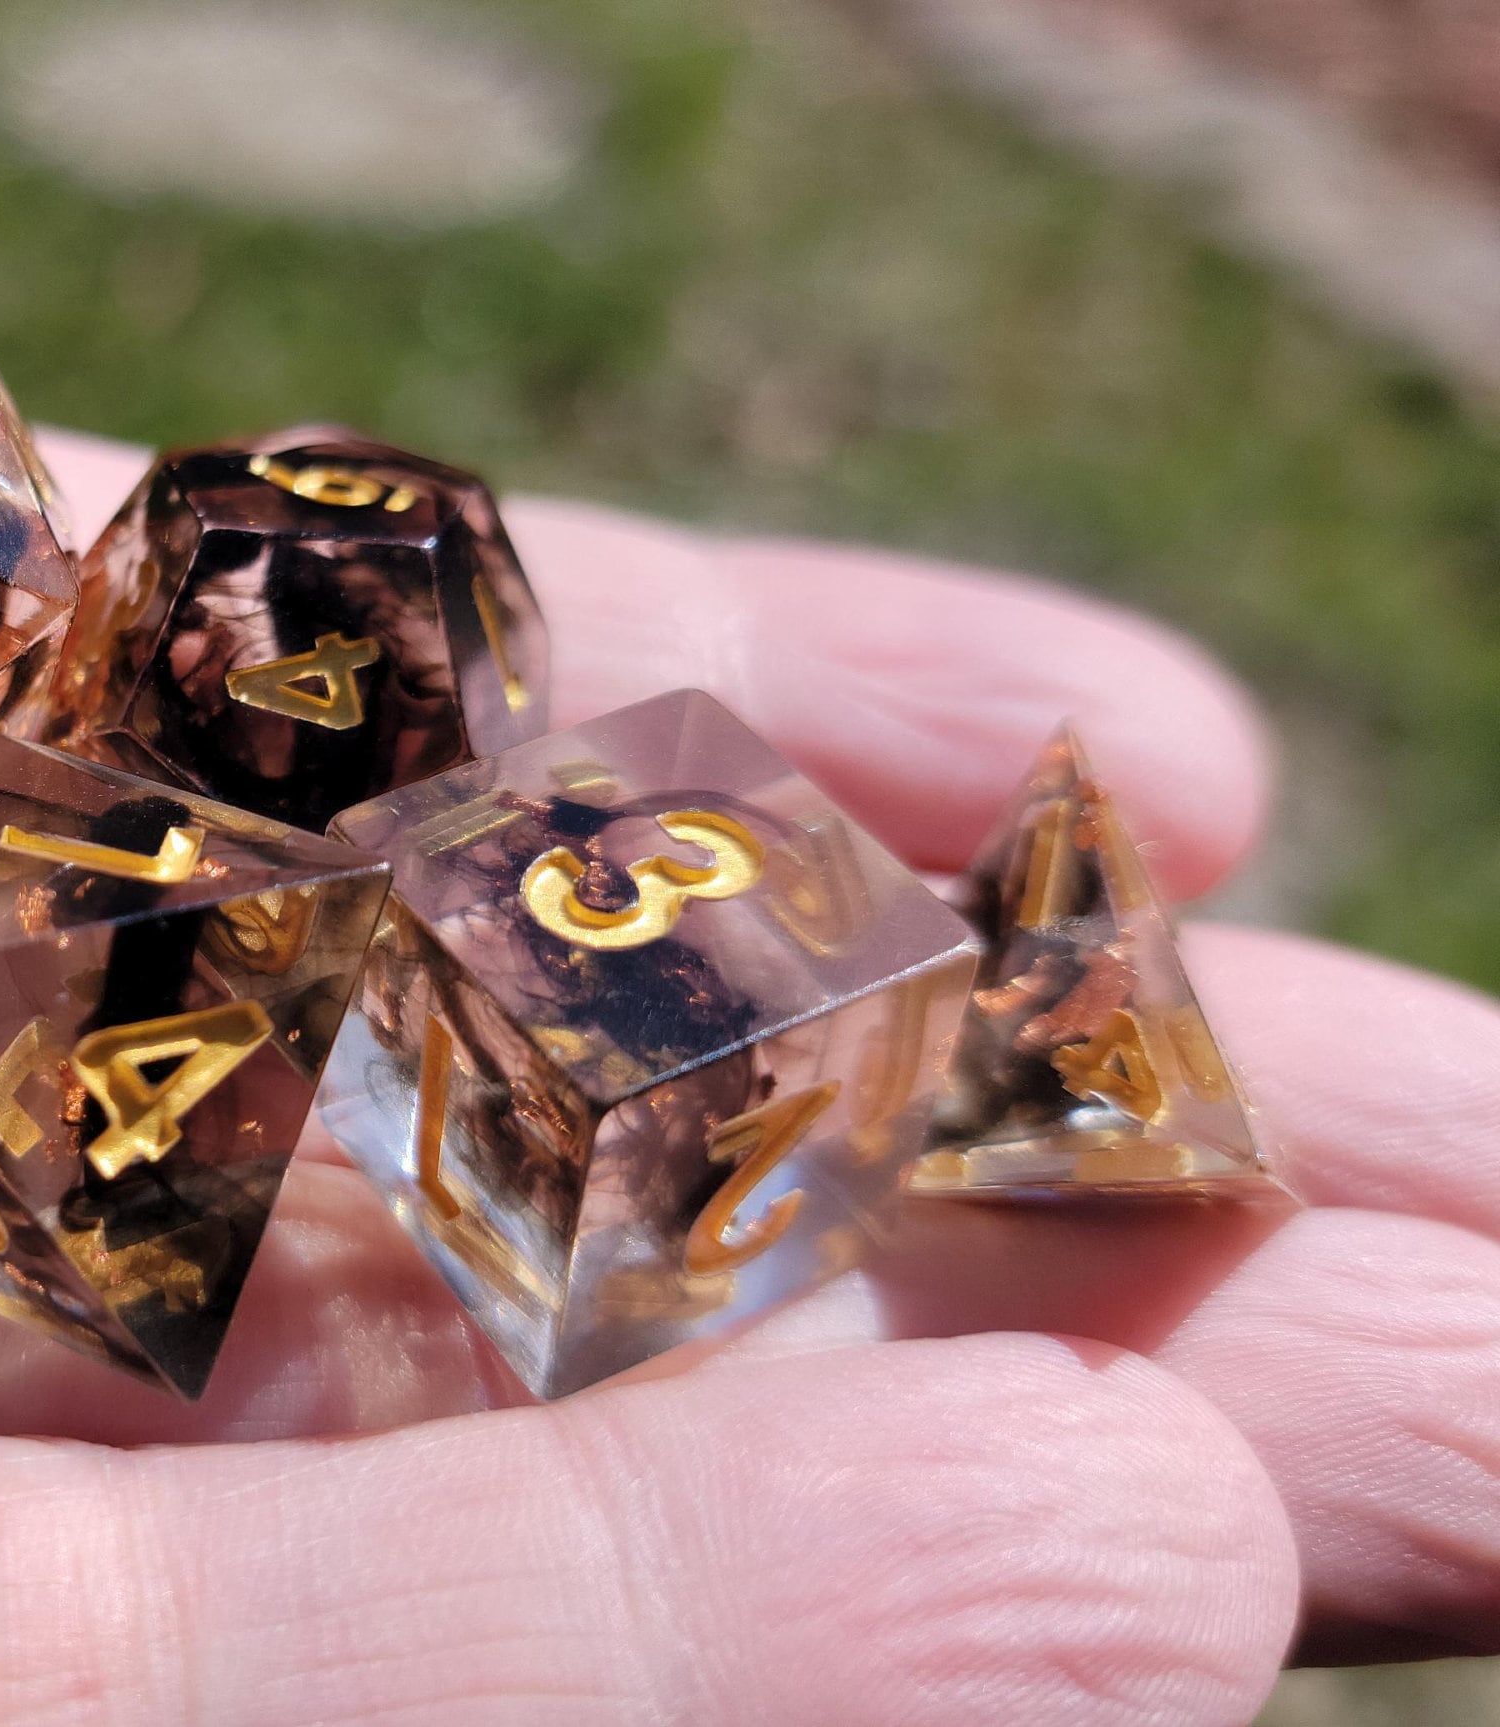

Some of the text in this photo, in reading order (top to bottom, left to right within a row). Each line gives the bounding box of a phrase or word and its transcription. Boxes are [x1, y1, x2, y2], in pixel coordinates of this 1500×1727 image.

[224, 632, 380, 731] 4
[520, 807, 766, 951] 3
[71, 998, 276, 1180] 4
